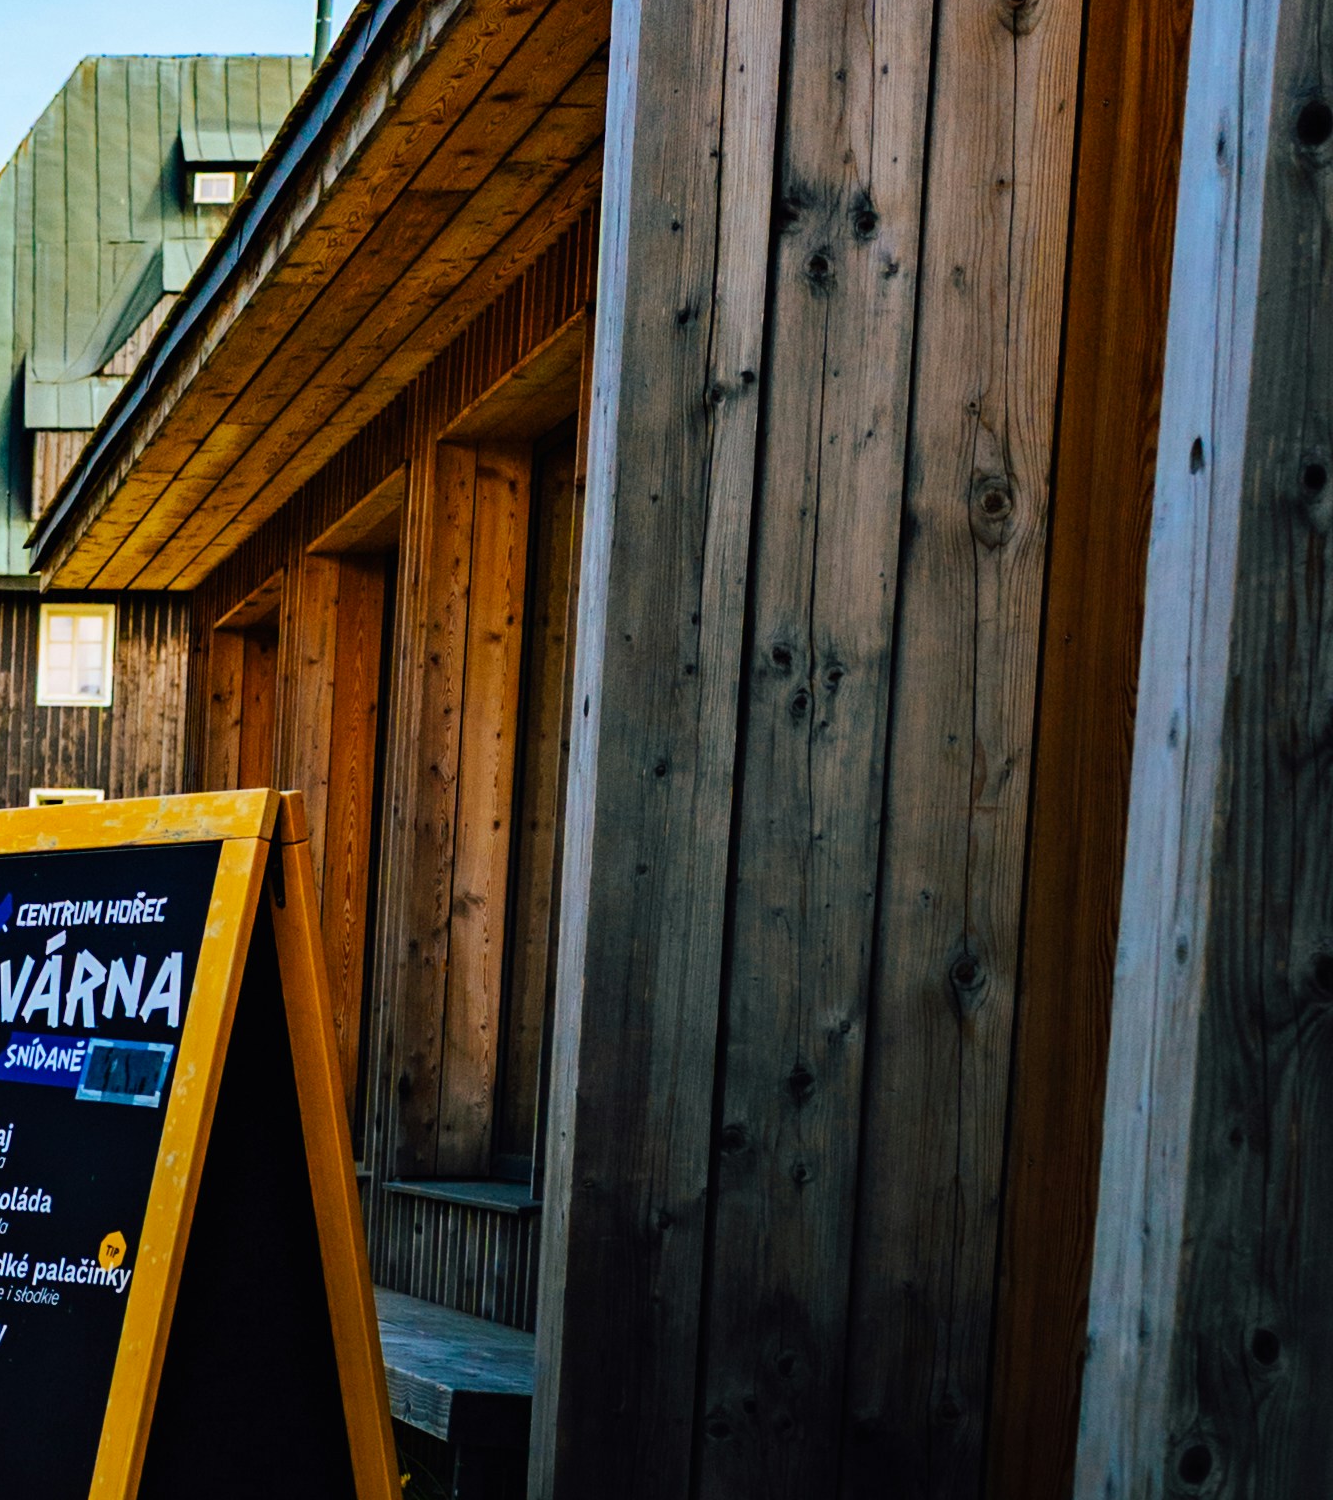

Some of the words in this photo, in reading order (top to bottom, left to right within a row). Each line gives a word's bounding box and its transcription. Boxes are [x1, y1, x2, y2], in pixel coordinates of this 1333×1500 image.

[16, 899, 101, 927] CENTRUM
[104, 891, 168, 925] HOŘEC
[4, 1037, 85, 1072] SNÍDANĚ
[105, 1244, 120, 1259] TIP
[32, 1257, 132, 1294] palačinky
[7, 1284, 14, 1299] i
[14, 1287, 60, 1306] słodkie
